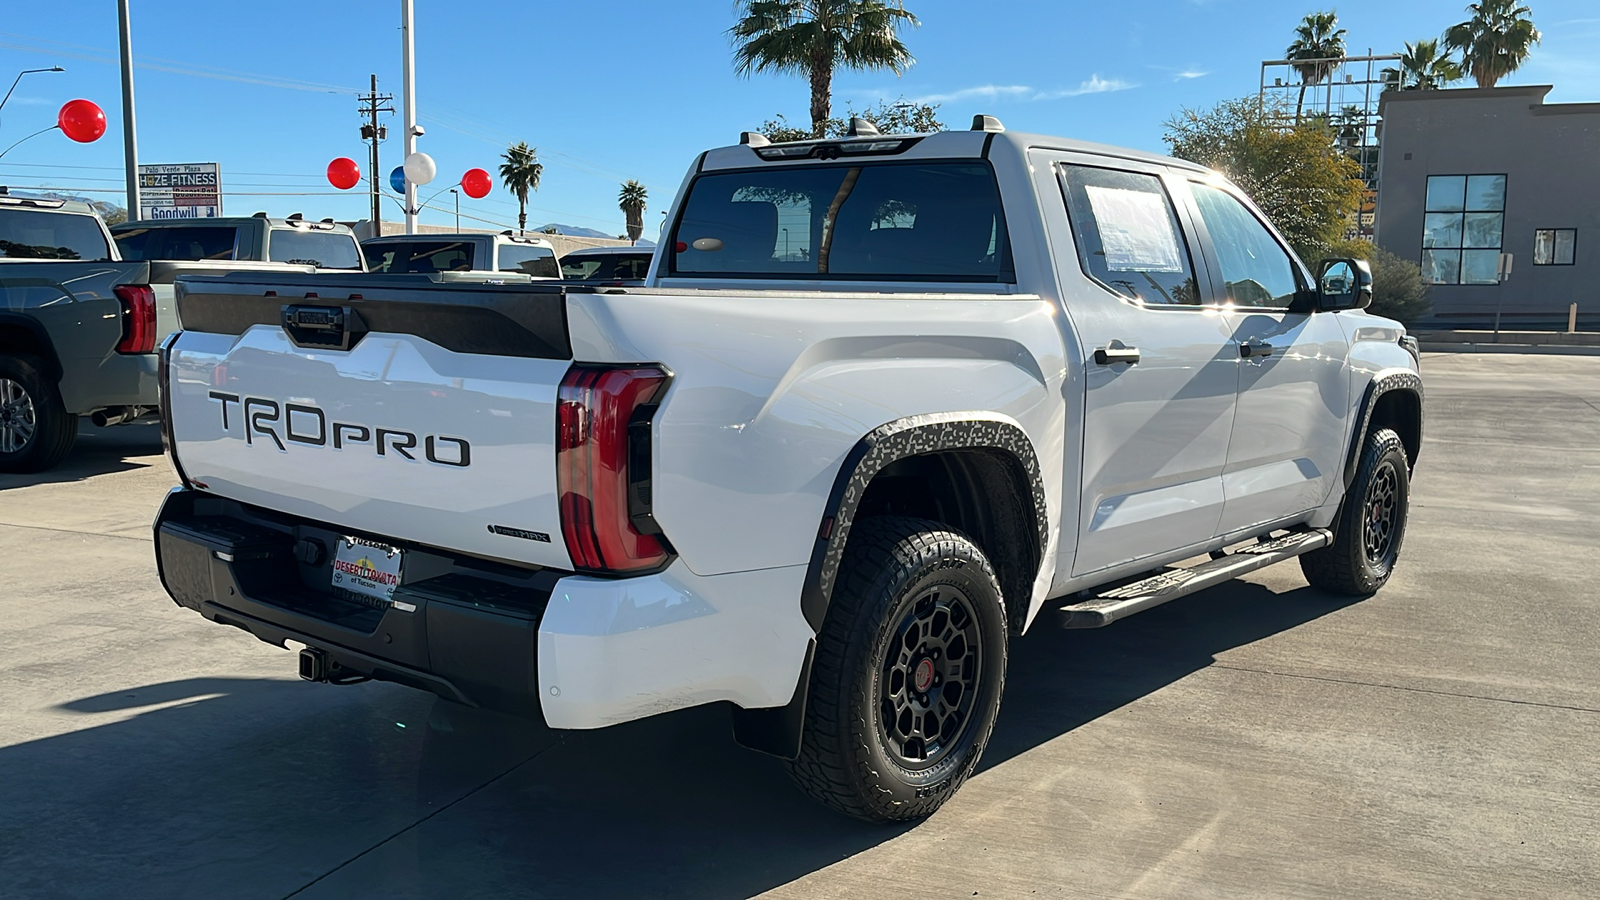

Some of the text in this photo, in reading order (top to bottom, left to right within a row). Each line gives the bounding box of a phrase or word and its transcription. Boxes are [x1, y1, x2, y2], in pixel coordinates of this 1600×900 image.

[171, 173, 215, 186] FITNESS
[151, 206, 198, 219] Goodwill
[335, 560, 397, 586] DESERT TOYOTA
[357, 579, 376, 590] Tucson
